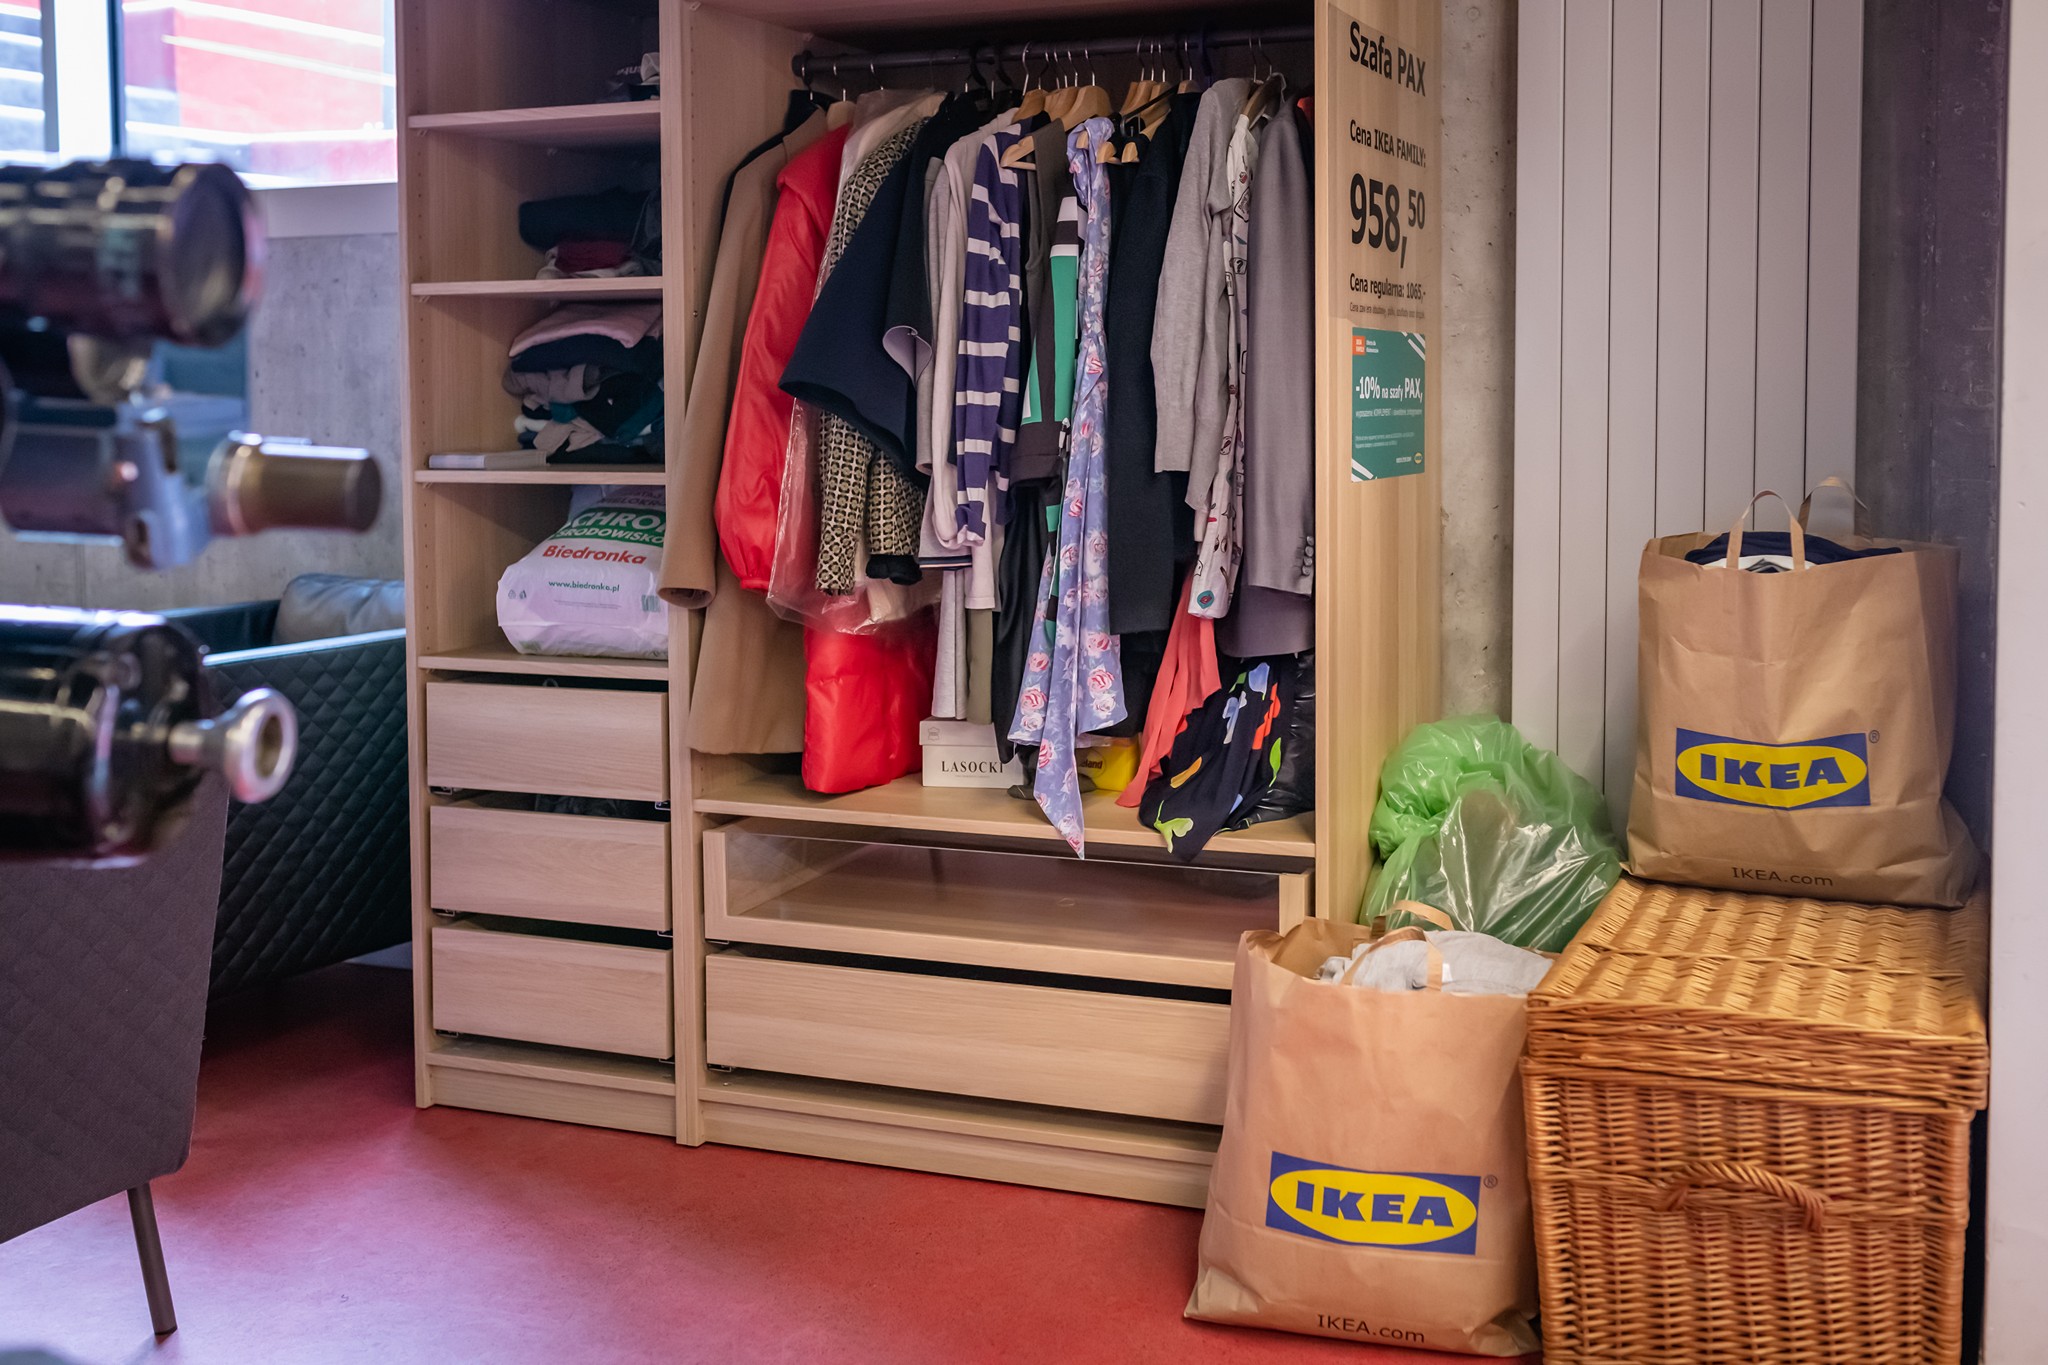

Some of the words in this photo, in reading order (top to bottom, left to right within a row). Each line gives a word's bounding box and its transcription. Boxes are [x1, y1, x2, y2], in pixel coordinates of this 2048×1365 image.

[1350, 21, 1392, 80] Szafa
[1398, 47, 1426, 97] PAX
[1350, 119, 1371, 147] Cena
[1374, 129, 1395, 156] IKEA
[1397, 138, 1426, 168] FAMILY:
[1350, 273, 1368, 293] Cena
[1356, 376, 1380, 399] -10%
[1382, 387, 1389, 398] na
[1405, 378, 1423, 403] PAX,
[542, 545, 647, 565] Biedronka
[548, 580, 620, 592] www.biedronka.pl
[942, 761, 1004, 773] LASOCKI
[1700, 753, 1847, 790] IKEA
[1732, 867, 1833, 887] IKEA.com
[1295, 1180, 1454, 1228] IKEA
[1317, 1314, 1425, 1343] IKEA.com
